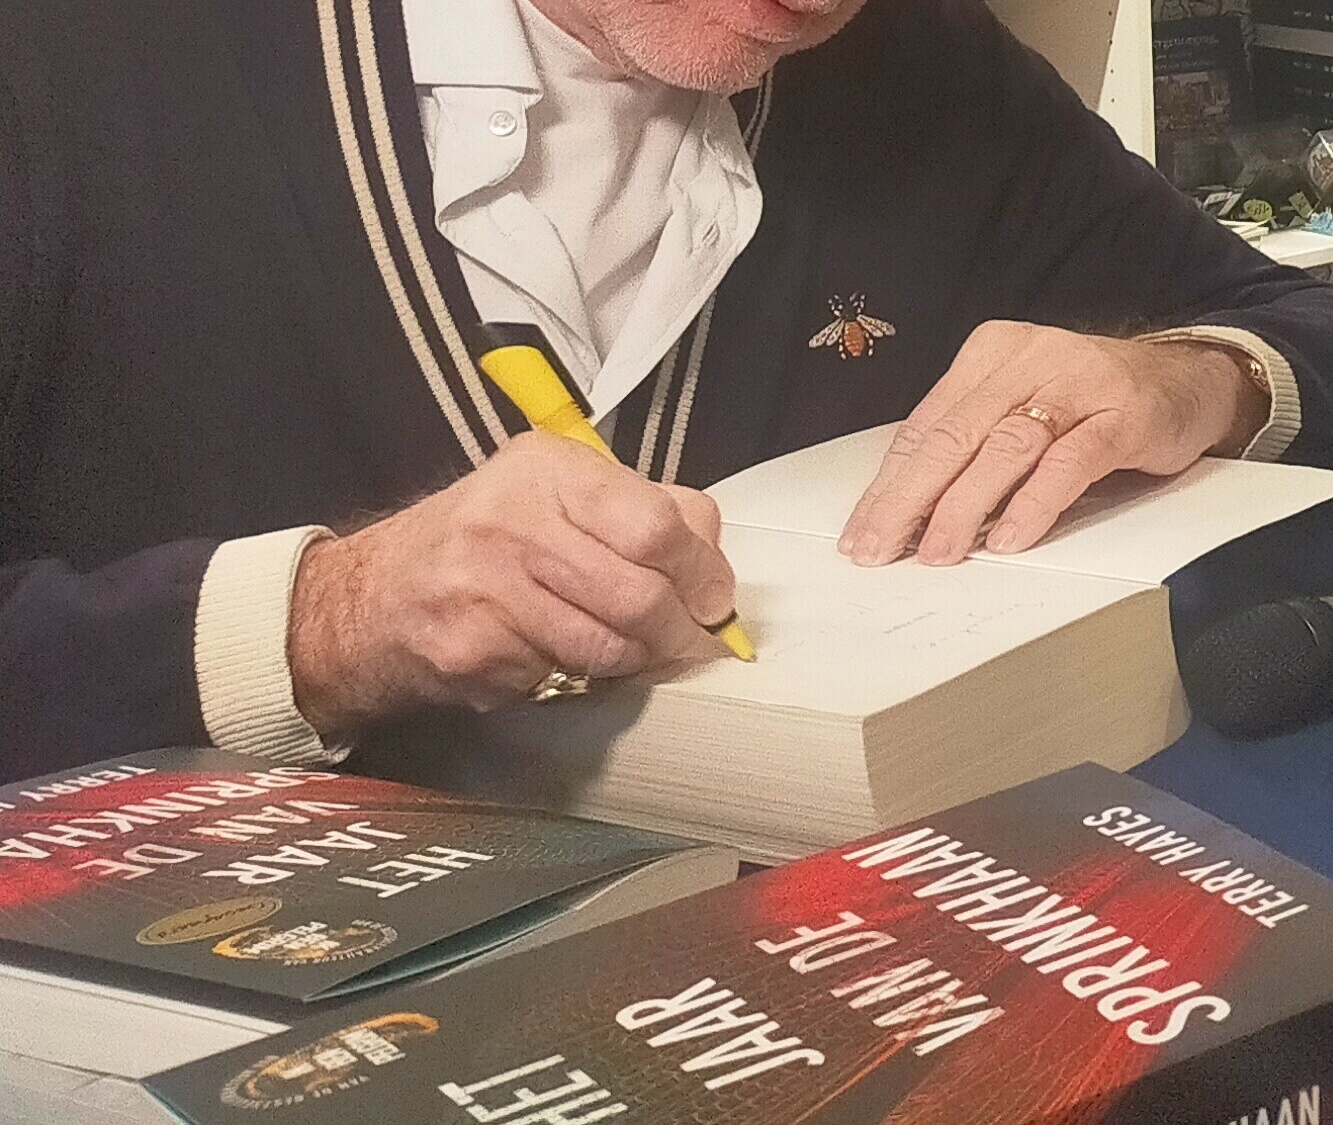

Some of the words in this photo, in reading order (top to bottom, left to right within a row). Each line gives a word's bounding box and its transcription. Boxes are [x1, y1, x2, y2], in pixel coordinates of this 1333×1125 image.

[0, 766, 342, 861] SPRINKHA
[18, 765, 158, 802] TERRY
[188, 798, 361, 843] VAN
[201, 820, 408, 885] JAAR
[1081, 805, 1207, 867] HAYES
[72, 842, 204, 881] DE
[337, 845, 497, 899] HET
[1178, 859, 1311, 930] TERRY
[753, 909, 900, 977] DE
[841, 824, 1235, 1046] SPRINKHAAN
[613, 976, 827, 1092] JAAR
[829, 956, 1007, 1058] VAN
[437, 1053, 629, 1125] HET
